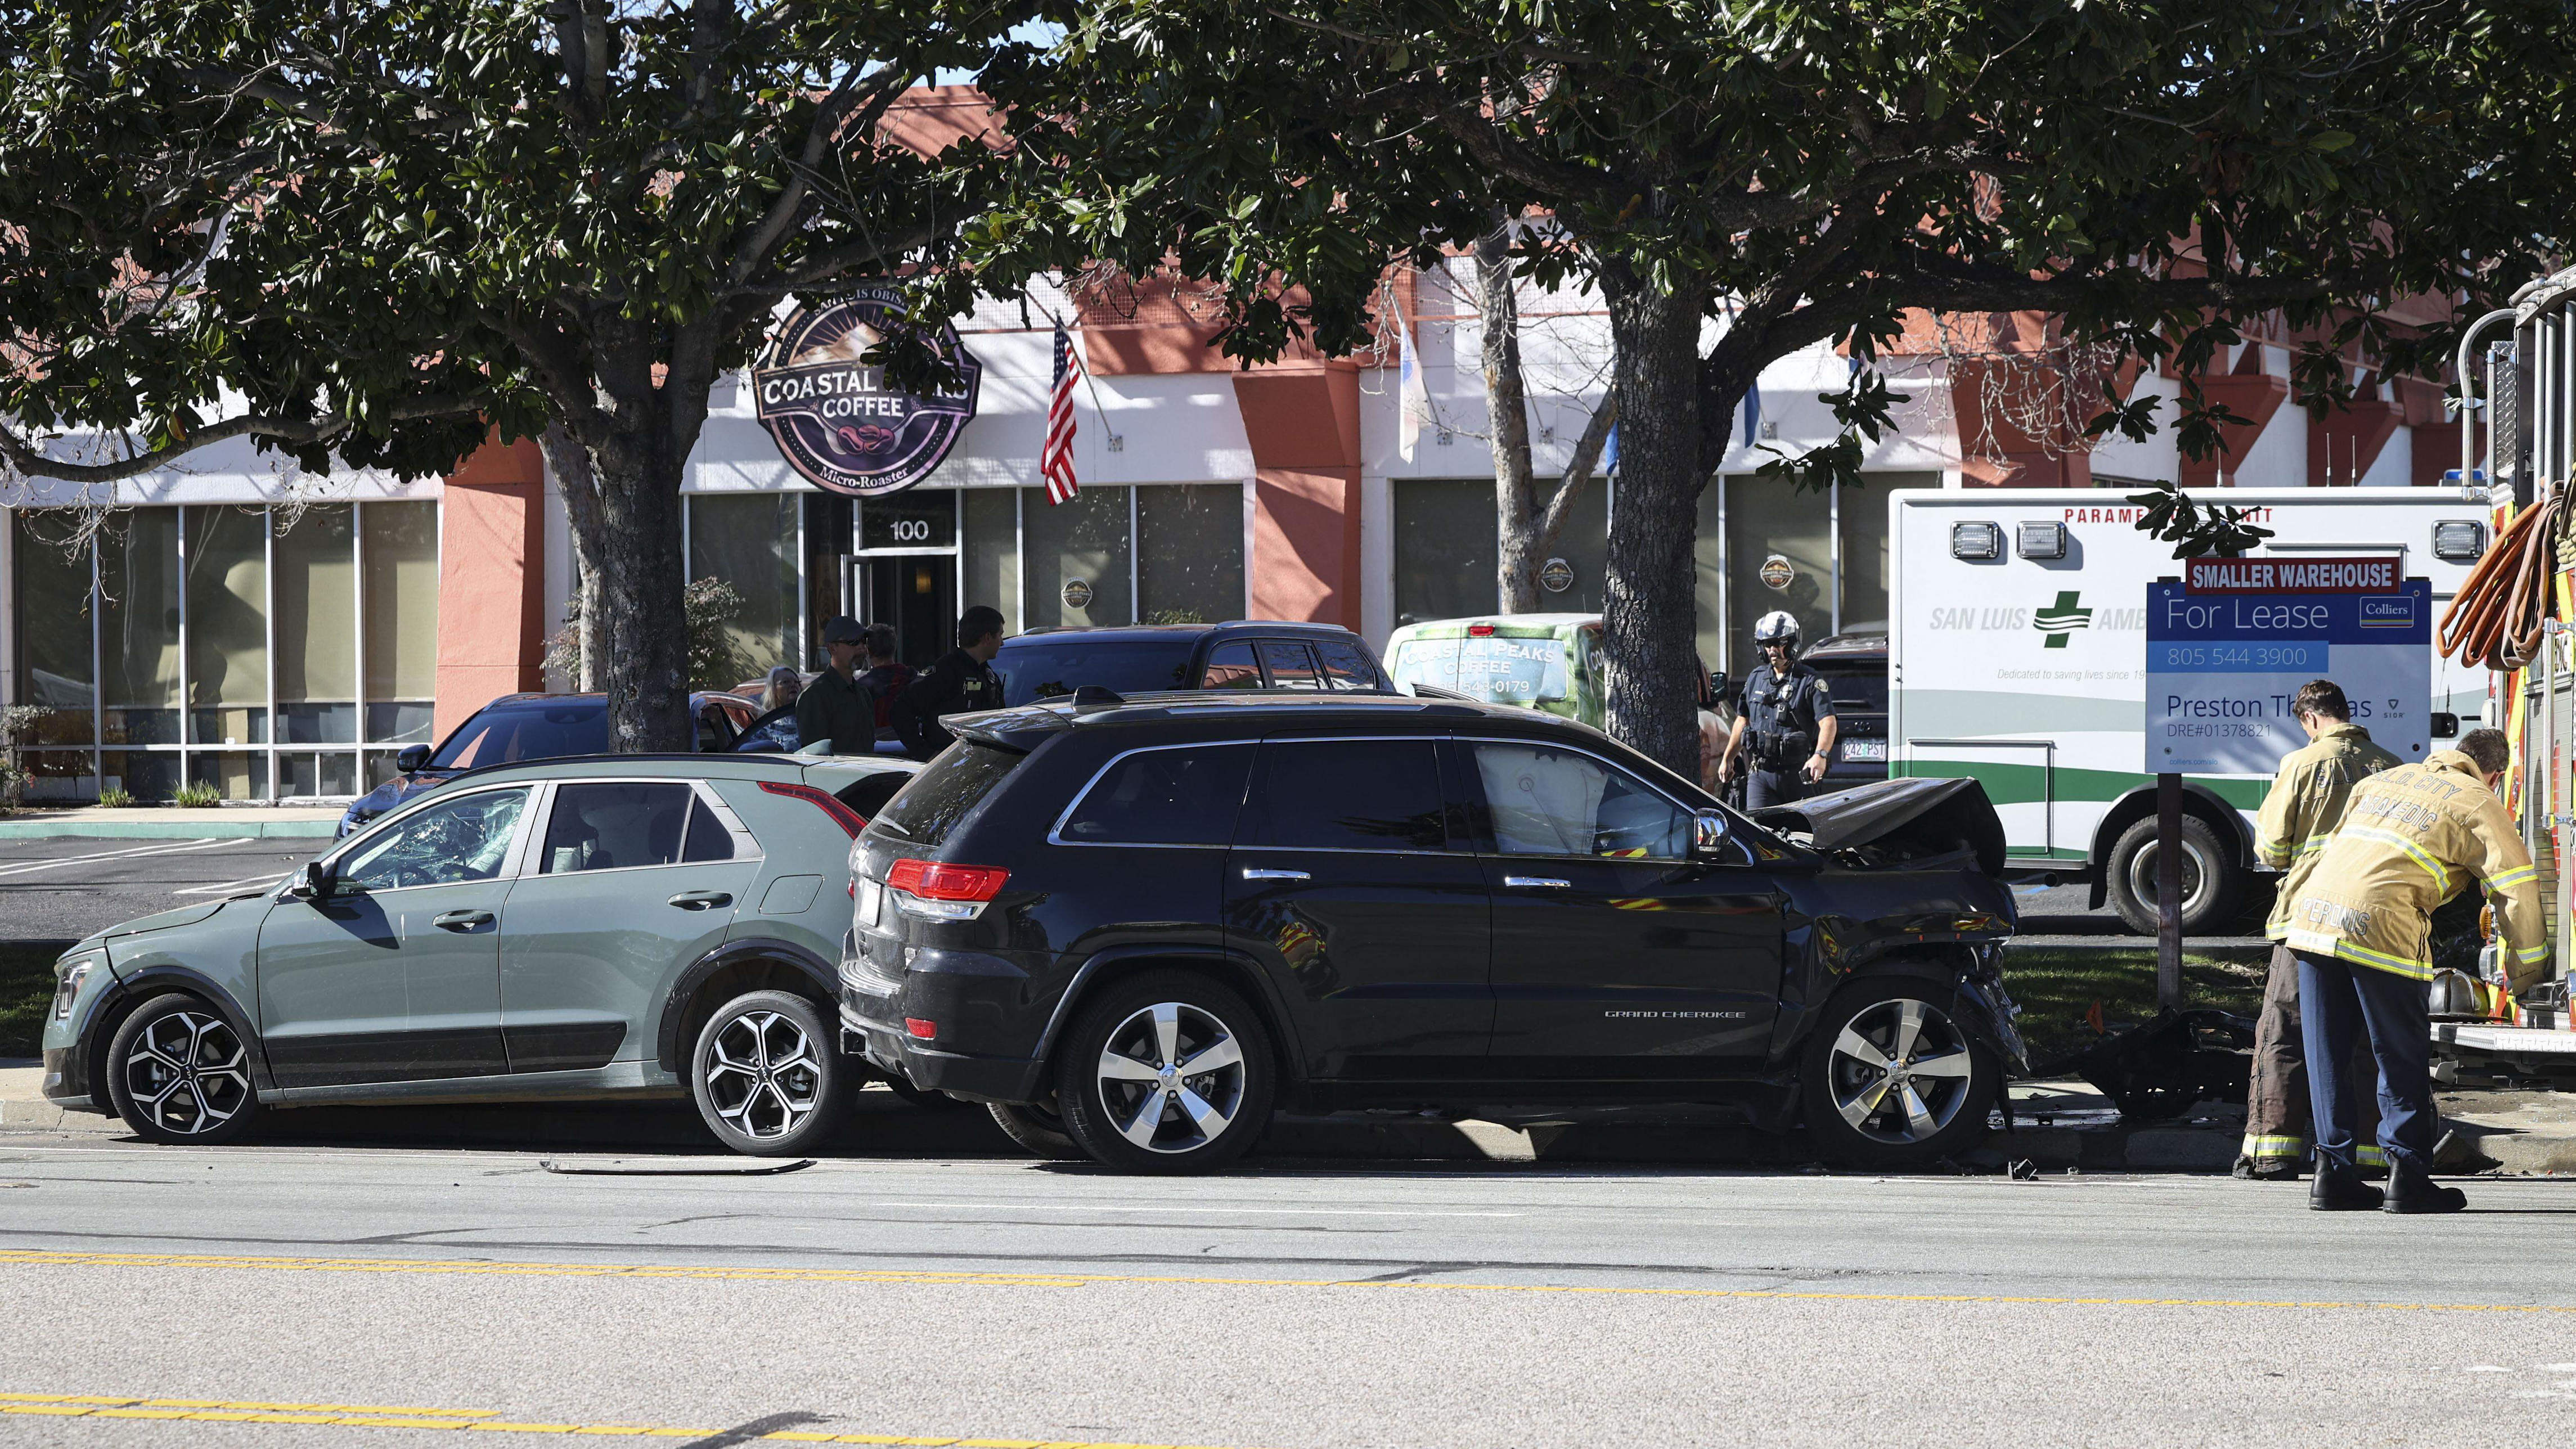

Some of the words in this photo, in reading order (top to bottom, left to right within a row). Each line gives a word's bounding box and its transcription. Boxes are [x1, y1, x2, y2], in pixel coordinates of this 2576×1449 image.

[764, 370, 877, 404] COASTAL
[822, 395, 904, 418] COFFEE
[820, 466, 909, 489] Micro-Roaster
[890, 520, 929, 541] 100
[2192, 565, 2274, 588] SMALLER
[2279, 563, 2392, 587] WAREHOUSE
[1930, 608, 1976, 631] SAN
[1981, 608, 2026, 631] LUIS
[2098, 608, 2147, 631] AMB
[2168, 598, 2221, 629] For
[2236, 598, 2328, 629] Lease
[2366, 603, 2408, 615] Colliers
[1406, 644, 1487, 664] COASTAL
[1494, 644, 1555, 663] PEAKS
[2168, 648, 2205, 665] 805
[2213, 648, 2250, 665] 544
[2256, 648, 2307, 665] 3900
[1444, 661, 1512, 675] COFFEE
[1998, 669, 2040, 680] Dedicated
[2043, 669, 2052, 679] to
[2054, 670, 2082, 681] saving
[2084, 670, 2103, 680] lives
[2106, 670, 2129, 680] since
[2134, 671, 2146, 680] 19
[2167, 695, 2262, 718] Preston
[2271, 695, 2372, 718] Thas
[2167, 723, 2271, 737] DRE#01378821
[1845, 742, 1862, 755] 242
[1868, 742, 1886, 755] PST
[2413, 775, 2462, 800] CITY
[2355, 794, 2437, 832] ARAMEDIC
